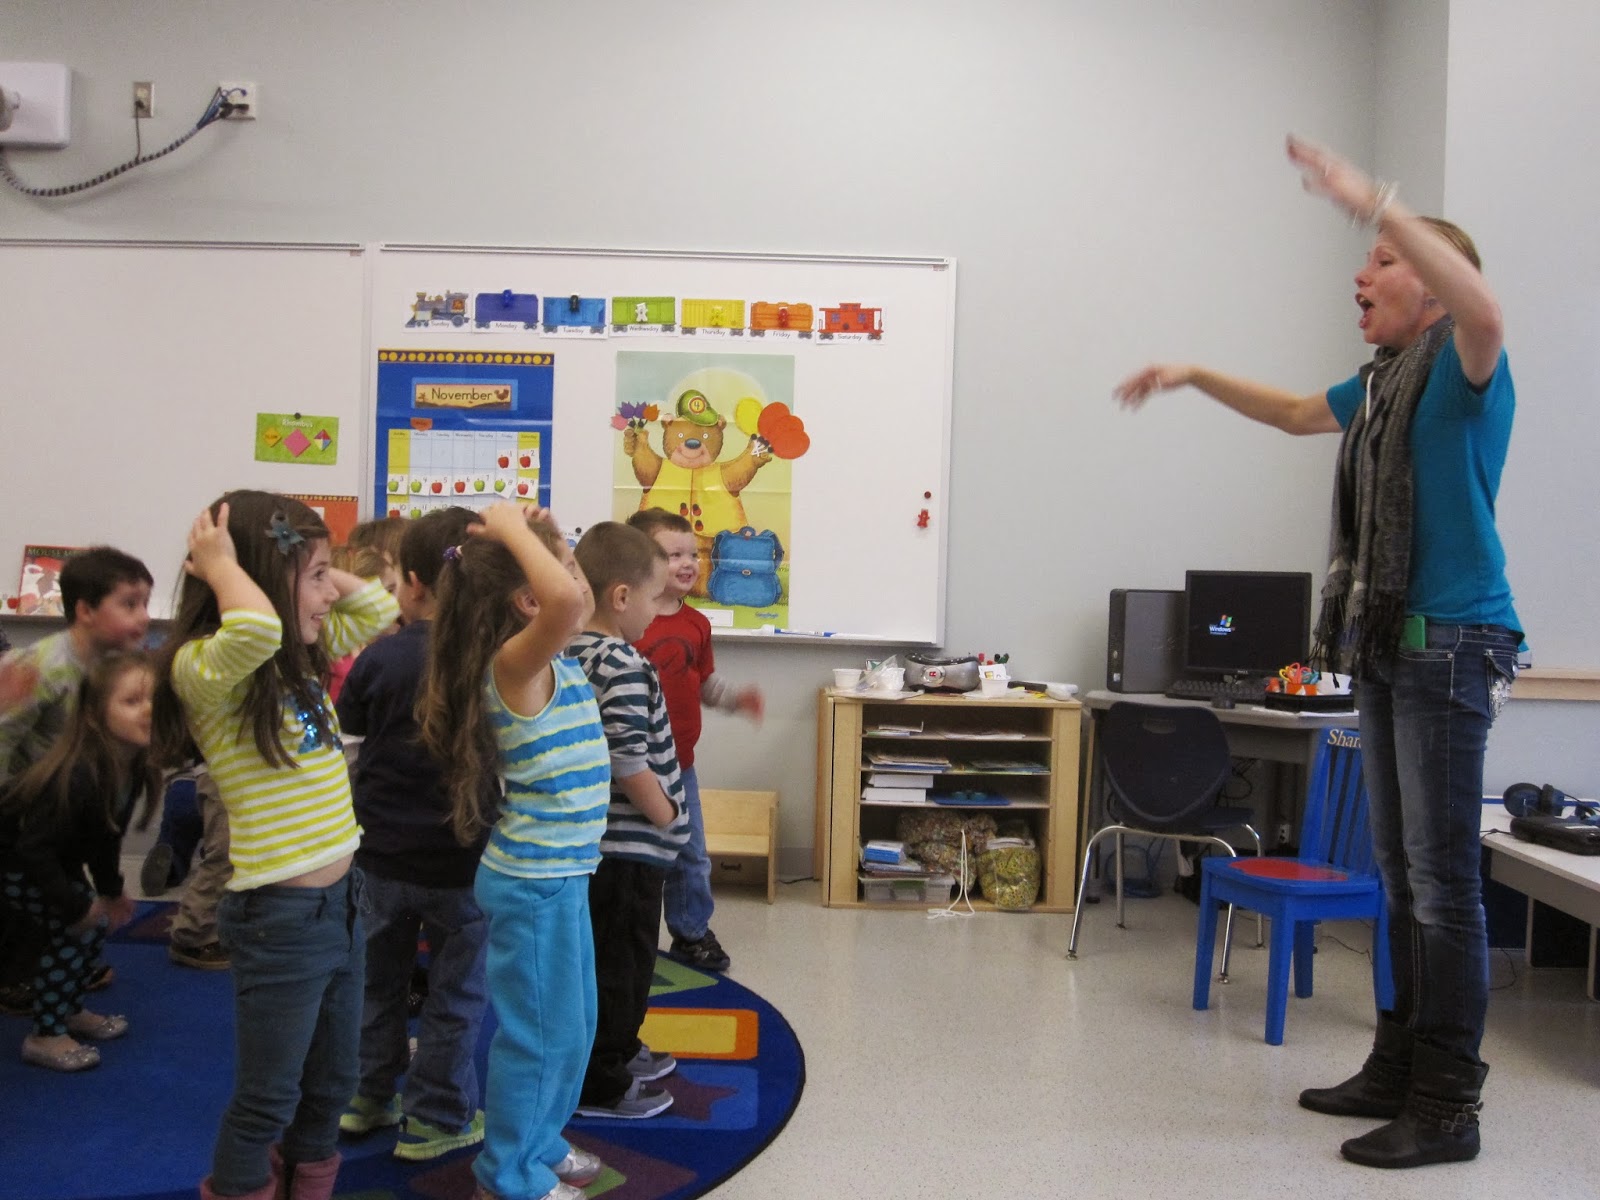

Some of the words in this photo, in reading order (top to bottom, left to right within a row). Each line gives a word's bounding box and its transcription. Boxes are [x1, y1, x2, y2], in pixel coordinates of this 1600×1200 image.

[495, 322, 518, 330] Monday
[563, 326, 584, 334] Tuesday
[629, 325, 659, 334] Wednesday
[702, 328, 725, 336] Thursday
[772, 330, 791, 339] Friday
[837, 333, 862, 341] Saturday
[431, 388, 492, 401] November
